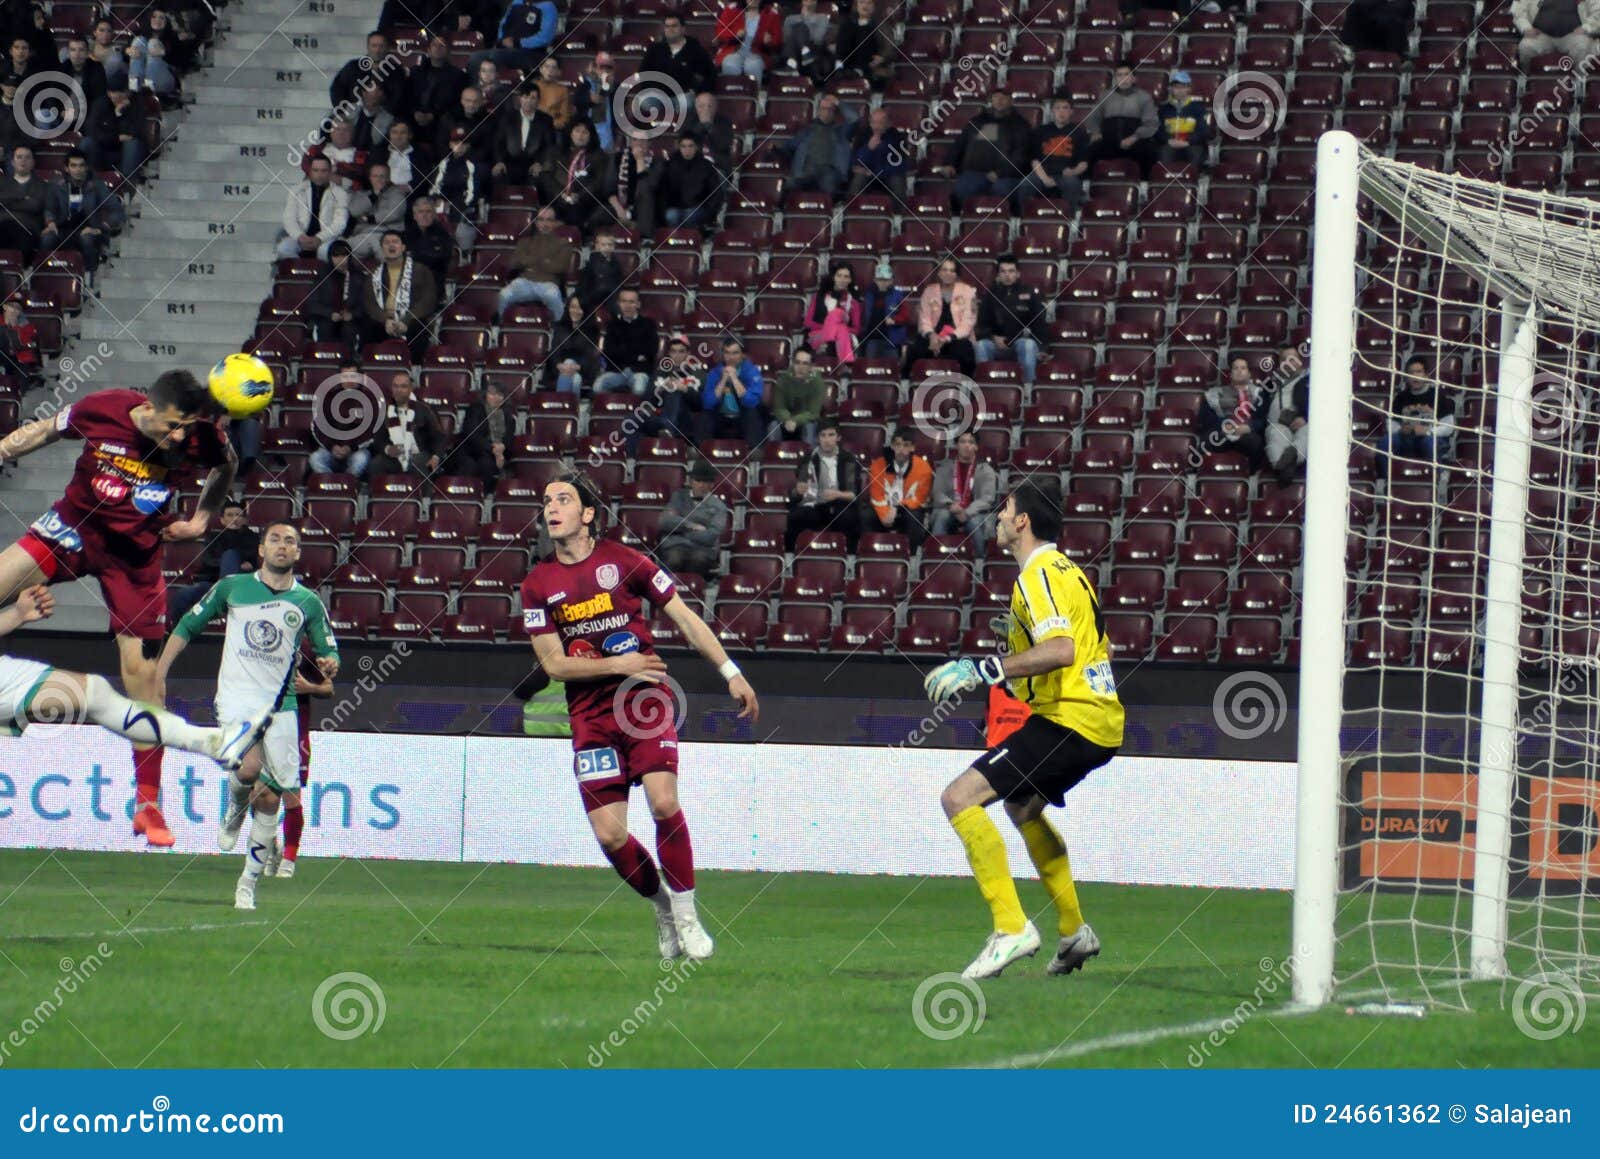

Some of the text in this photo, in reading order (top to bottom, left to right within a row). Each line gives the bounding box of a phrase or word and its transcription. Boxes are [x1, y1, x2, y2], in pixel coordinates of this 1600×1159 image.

[308, 2, 335, 13] R19
[276, 71, 302, 82] R17
[256, 108, 284, 120] R16
[240, 146, 267, 157] R15
[223, 184, 250, 196] R14
[208, 223, 236, 235] R13
[187, 263, 215, 275] R12
[167, 303, 195, 314] R11
[148, 344, 177, 356] R10
[563, 612, 630, 637] ANSILVANIA
[0, 763, 401, 831] cttins
[1361, 816, 1449, 833] DURAZIV
